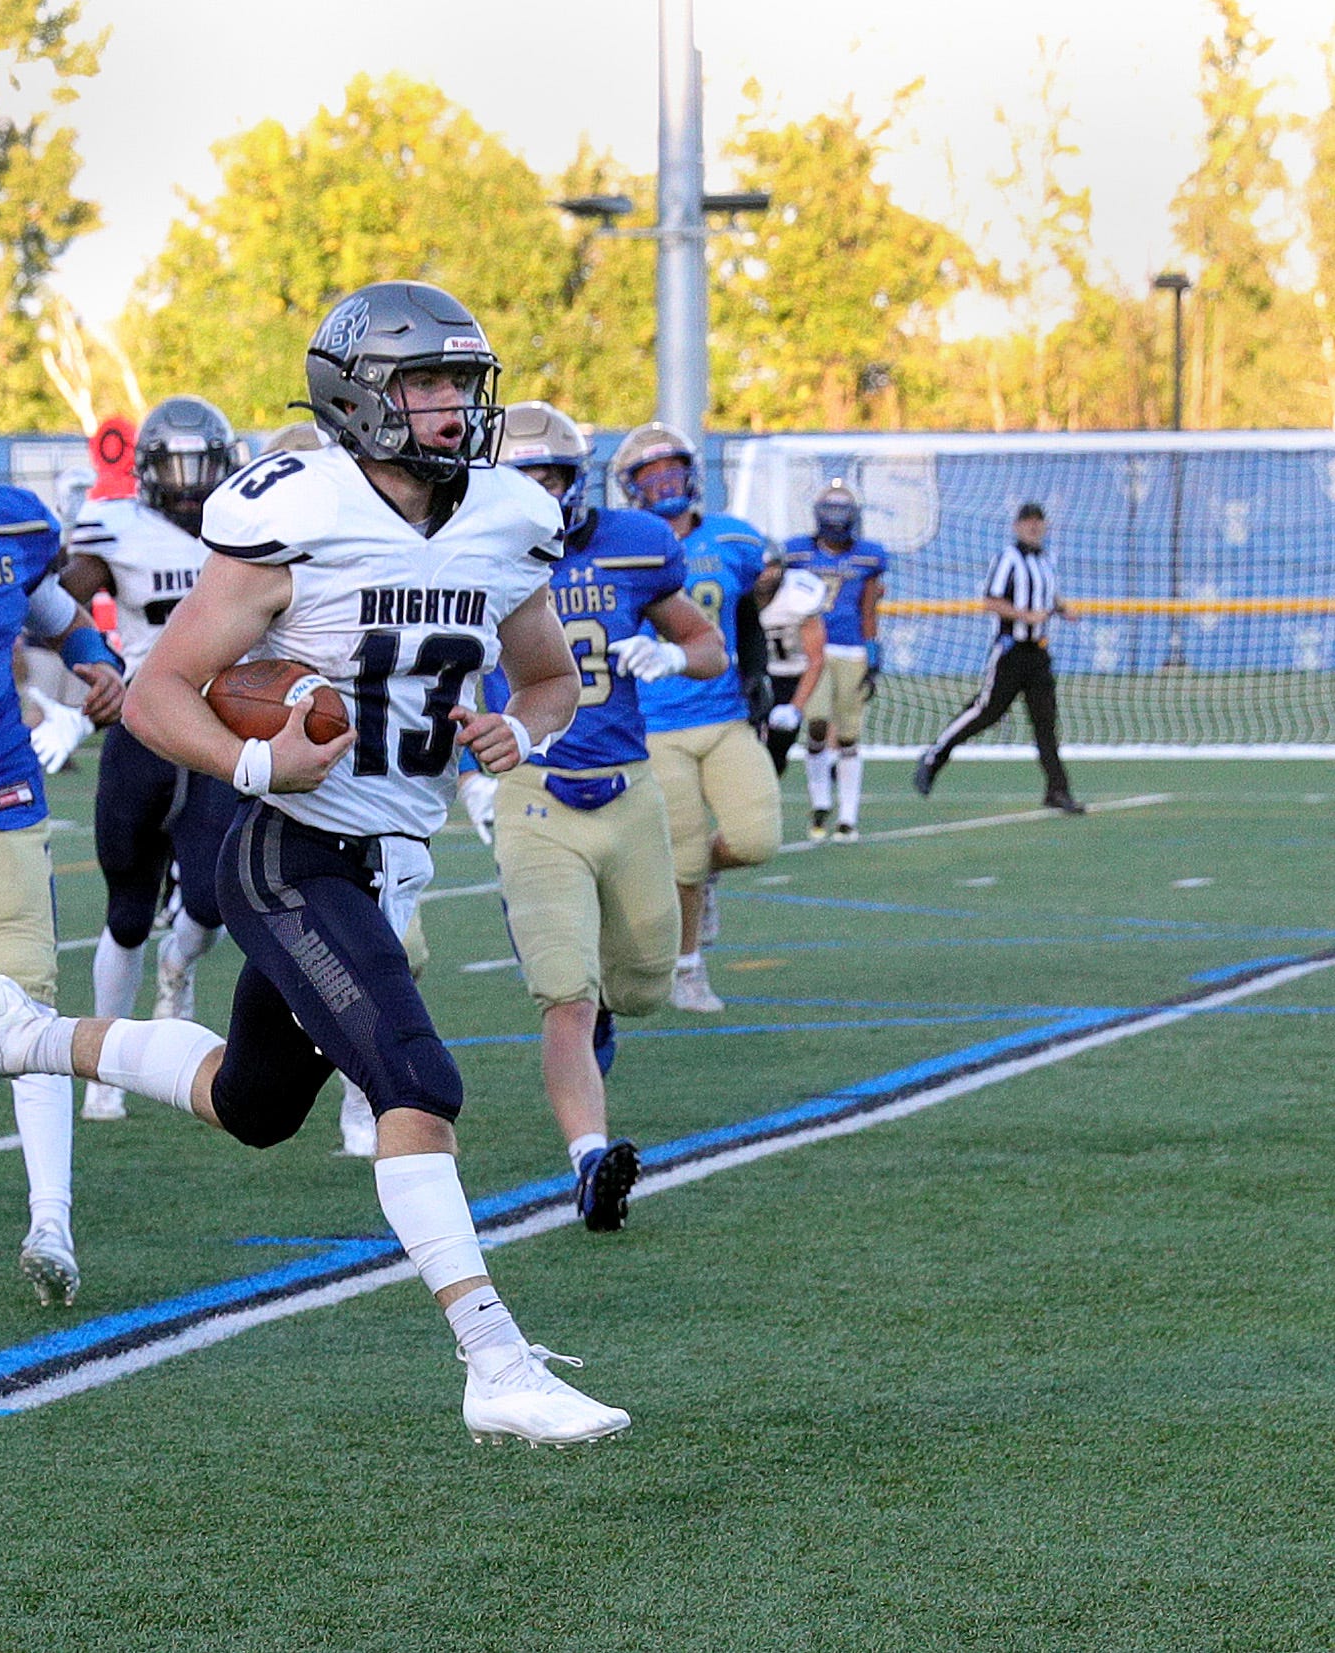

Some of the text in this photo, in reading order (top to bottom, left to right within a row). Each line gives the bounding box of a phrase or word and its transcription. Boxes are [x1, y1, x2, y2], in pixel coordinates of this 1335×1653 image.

[152, 570, 199, 592] BRIG
[358, 587, 488, 625] BRIGHTON
[349, 629, 486, 777] 13
